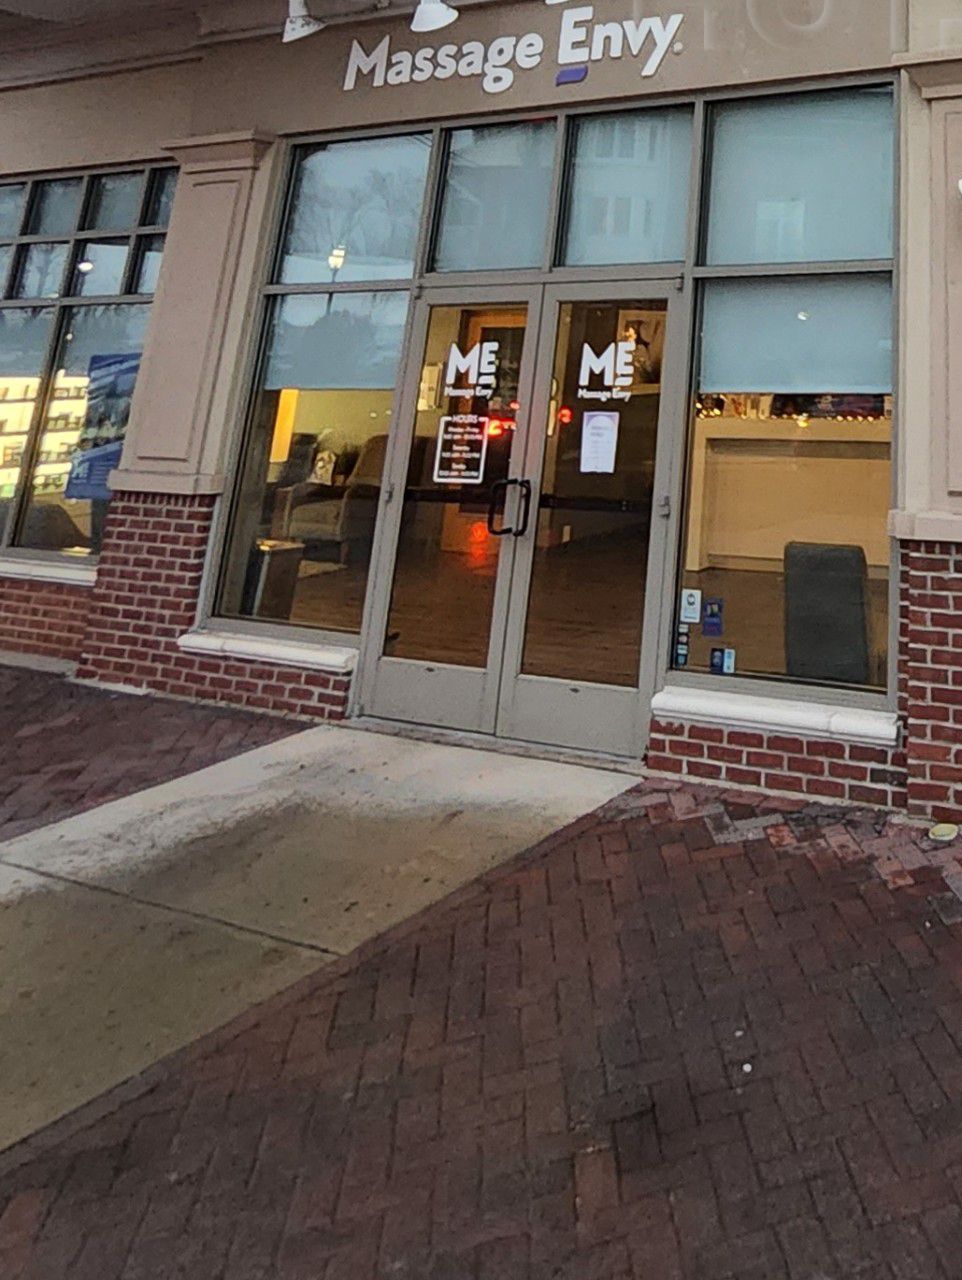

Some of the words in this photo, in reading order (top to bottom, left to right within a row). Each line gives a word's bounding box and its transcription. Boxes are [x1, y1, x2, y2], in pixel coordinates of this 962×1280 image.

[343, 34, 544, 93] Massage
[445, 341, 500, 385] ME
[578, 341, 636, 386] ME
[452, 414, 478, 424] HOURS
